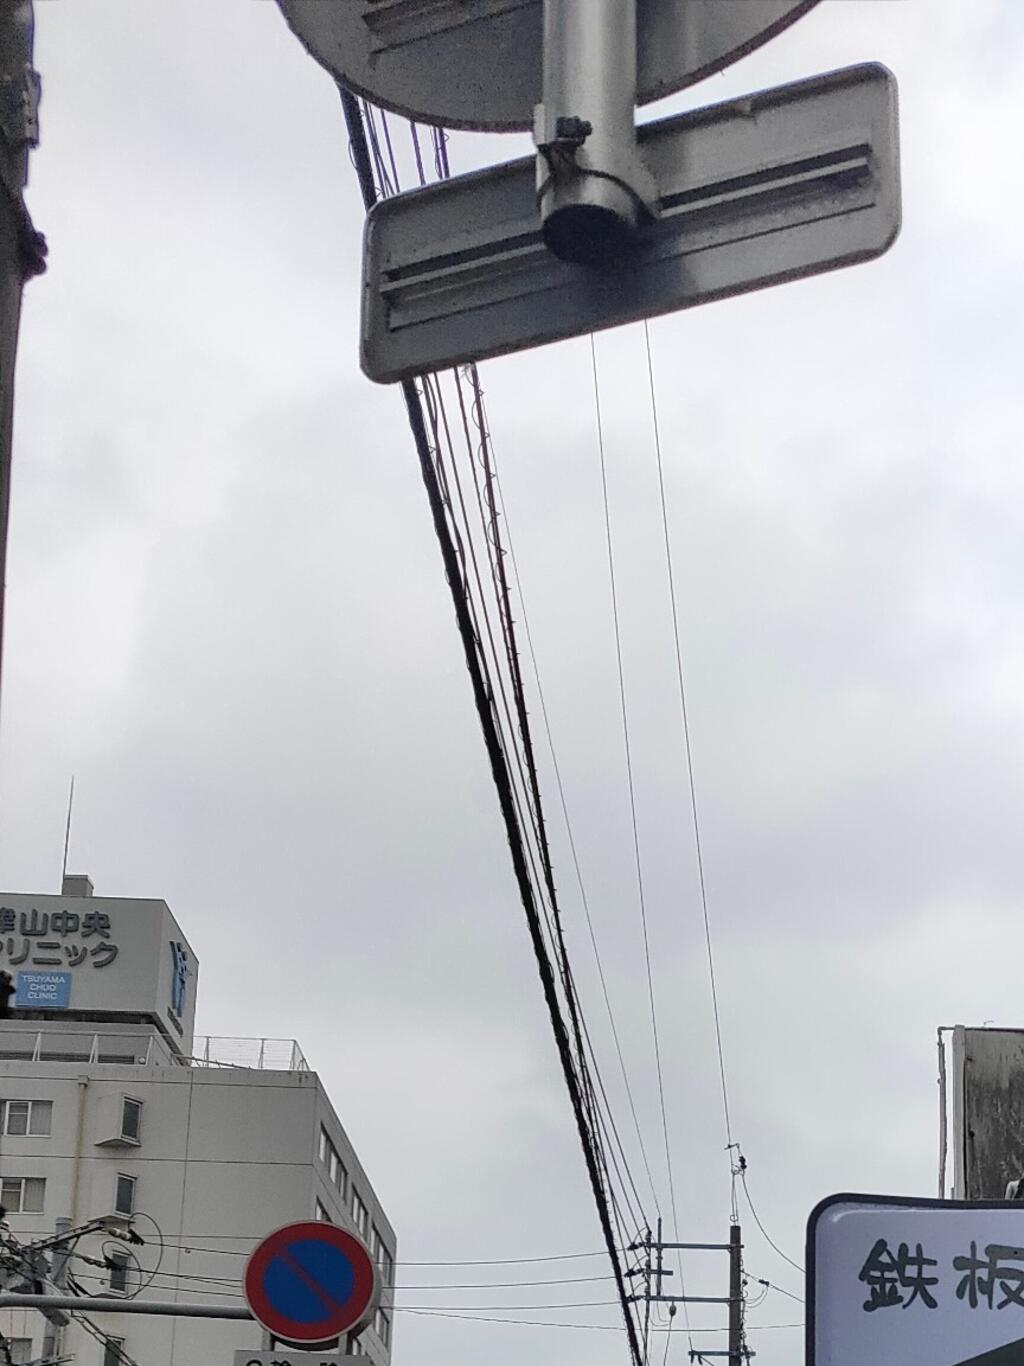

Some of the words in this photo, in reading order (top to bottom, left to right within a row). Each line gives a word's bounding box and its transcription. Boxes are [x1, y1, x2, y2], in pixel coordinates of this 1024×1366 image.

[0, 938, 119, 968] リニック
[23, 974, 65, 984] TSUYAMA
[30, 983, 57, 992] CHUO
[27, 991, 58, 1000] CLINIC
